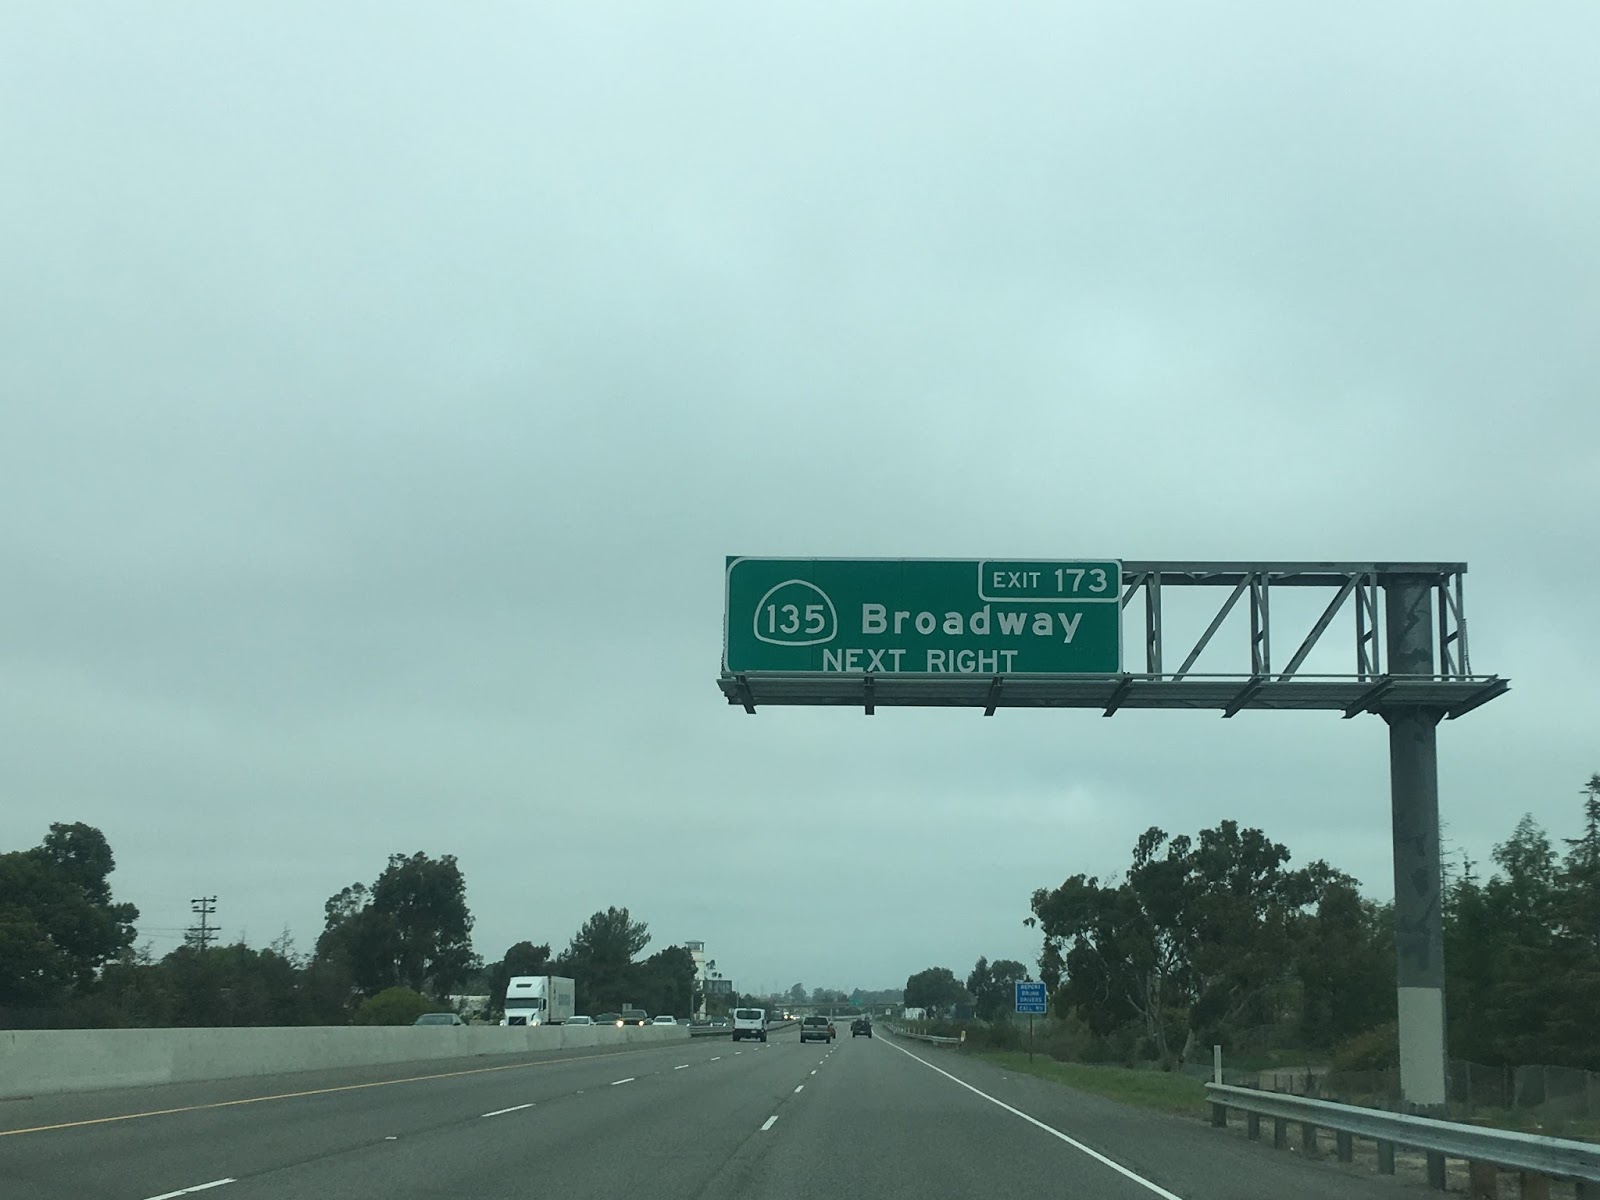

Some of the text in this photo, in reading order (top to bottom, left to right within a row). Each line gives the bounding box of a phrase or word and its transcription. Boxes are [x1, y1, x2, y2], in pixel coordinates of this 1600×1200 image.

[993, 568, 1108, 592] EXIT 173
[766, 604, 826, 634] 135
[861, 603, 1083, 644] Broadway
[822, 648, 1018, 673] NEXT RIGHT
